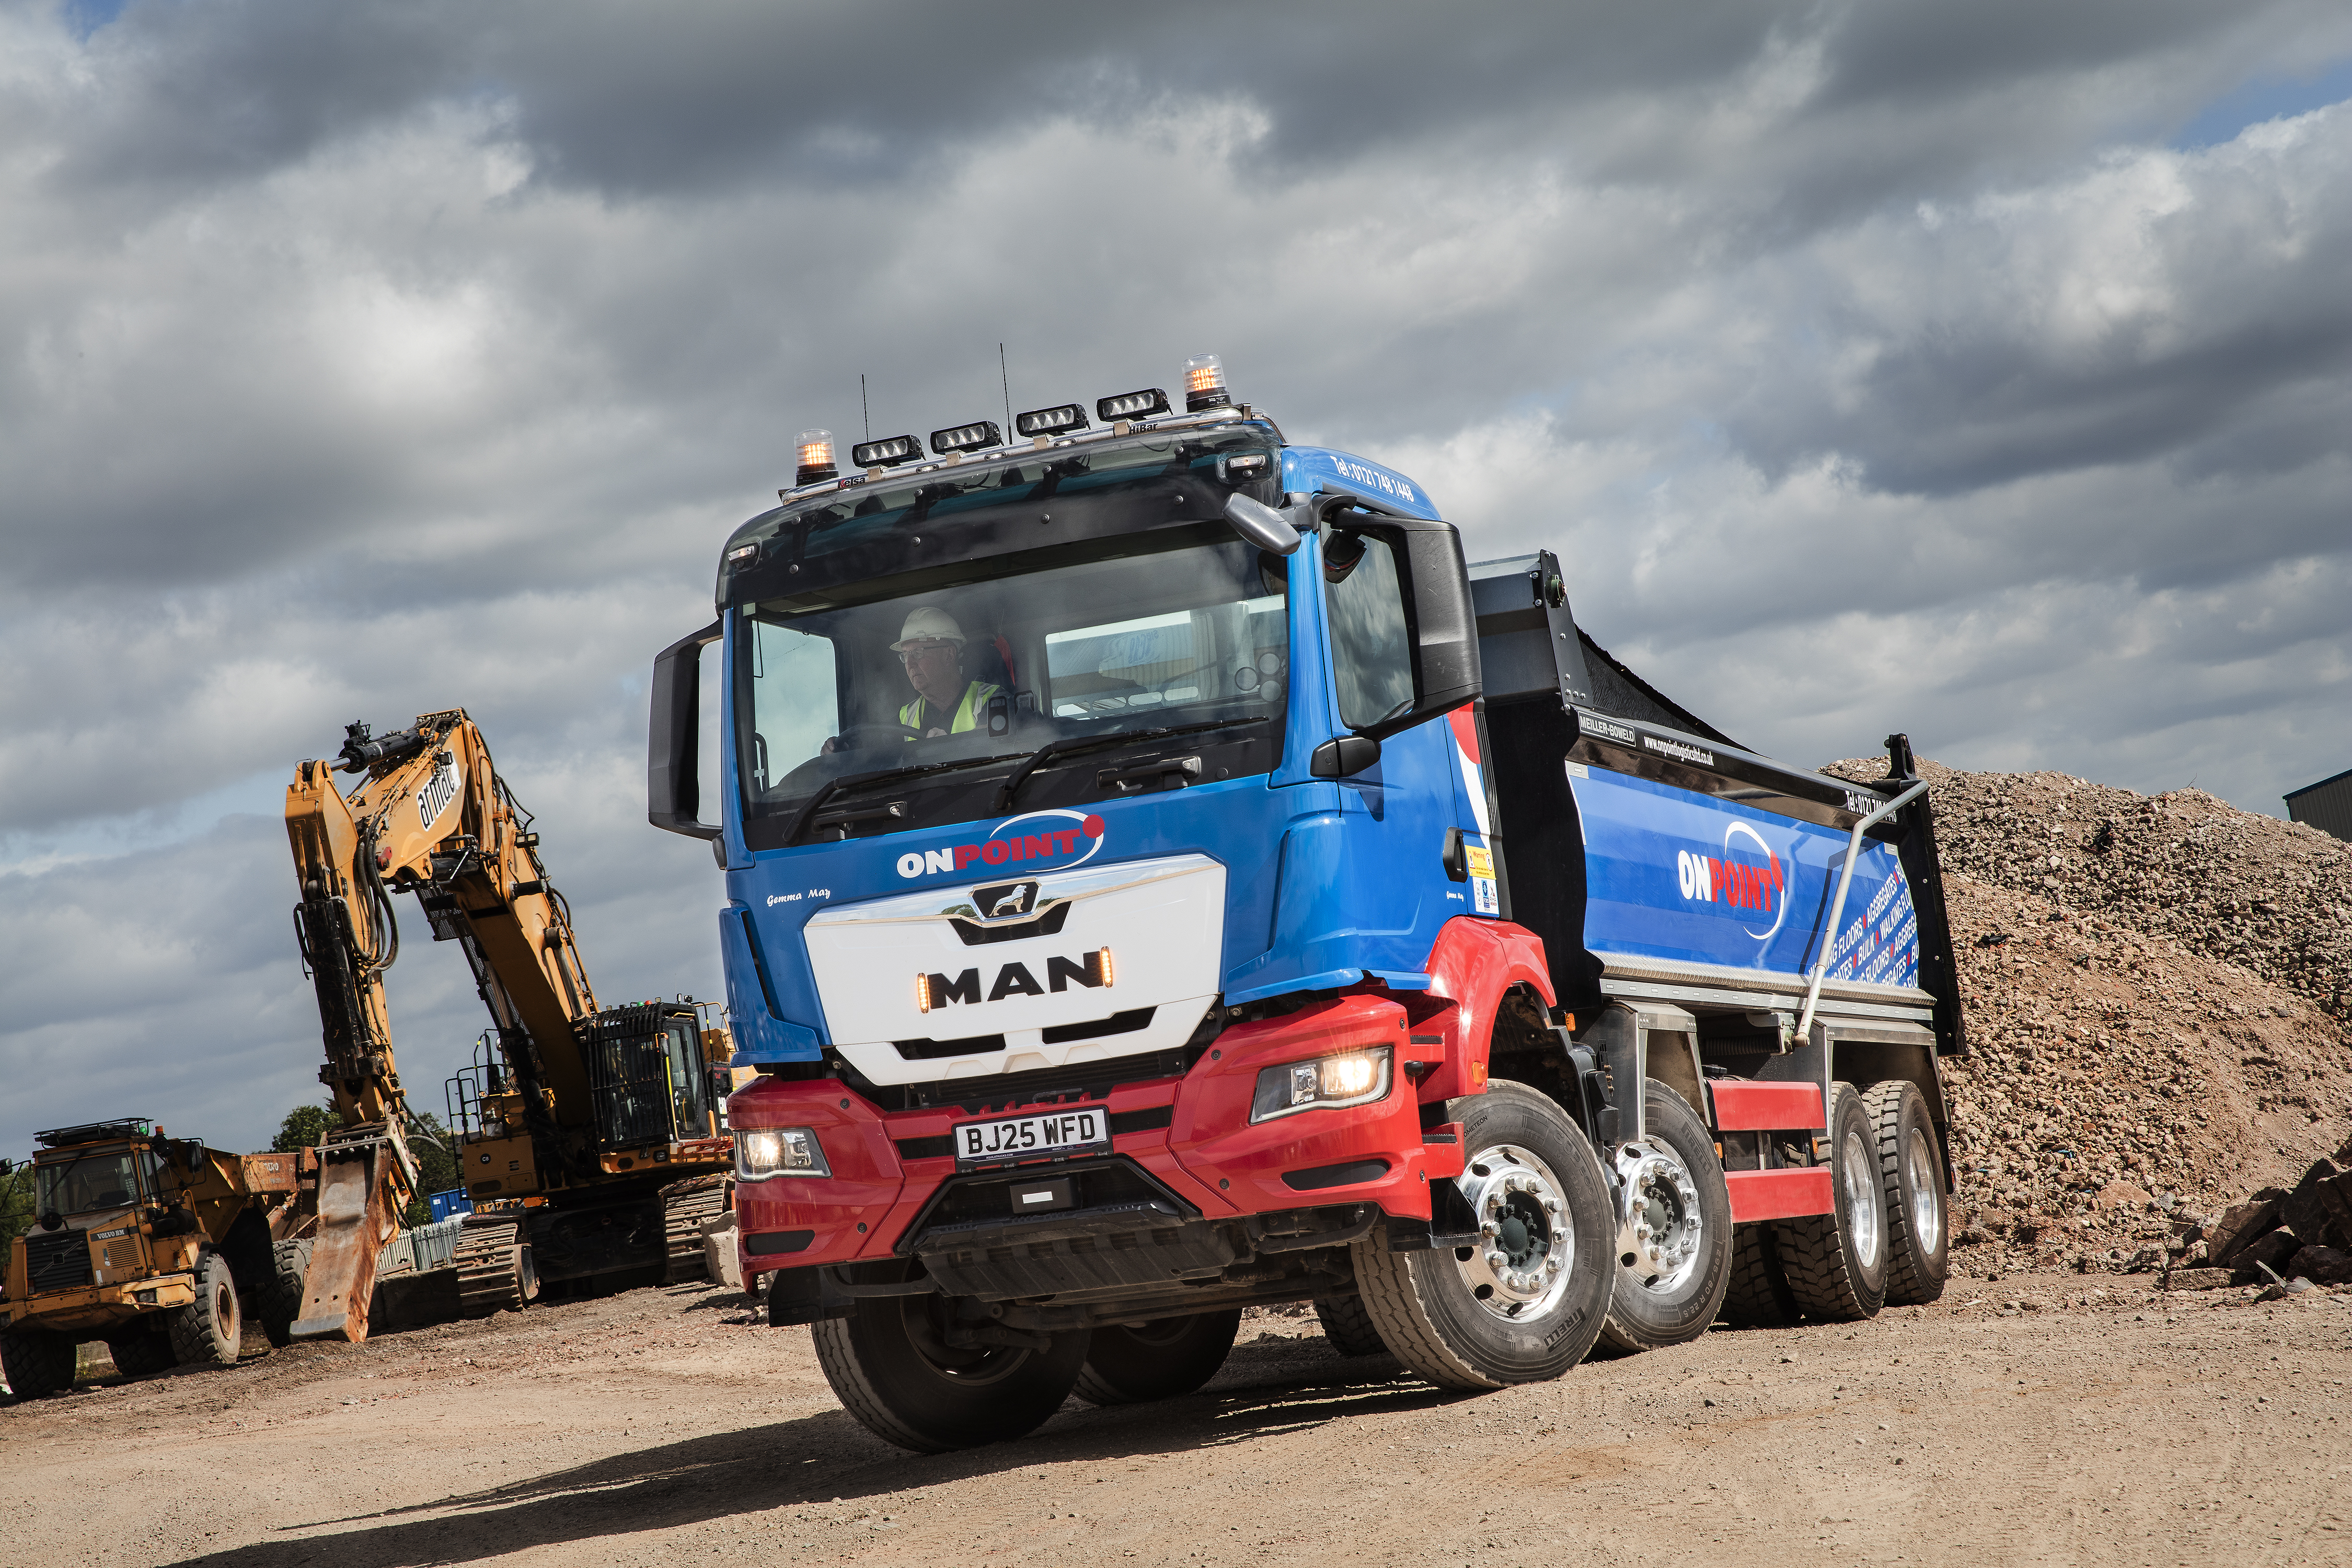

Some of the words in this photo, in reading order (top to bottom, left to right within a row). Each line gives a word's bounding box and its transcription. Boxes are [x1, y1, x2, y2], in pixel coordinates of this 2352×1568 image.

[1129, 423, 1158, 434] HiBar
[837, 477, 866, 488] Kelsa
[1374, 471, 1393, 494] 748
[1391, 479, 1414, 502] 1448
[1579, 716, 1634, 743] MEILLER-BOWELD
[1644, 736, 1714, 766] www.onpointlogisticsltd.co.uk
[896, 828, 1081, 879] ONPOINT
[1472, 851, 1485, 861] Warning
[1678, 850, 1772, 912] ONPOINT
[767, 893, 802, 907] Gemma
[808, 889, 831, 899] May
[1838, 917, 1863, 958] FLOORS
[1867, 873, 1897, 928] AGGREGATES
[1858, 932, 1875, 966] BULK
[1880, 900, 1903, 941] WALKING
[927, 951, 1104, 1009] MAN
[966, 1121, 1035, 1155] BJ25
[1042, 1114, 1096, 1145] WFD
[1463, 1115, 1488, 1137] OMETEON
[1681, 1121, 1713, 1175] PIRELLI
[1705, 1249, 1721, 1295] 295/80
[1683, 1302, 1699, 1318] 22.5
[1699, 1294, 1705, 1304] R
[1543, 1306, 1587, 1353] PIRELLI
